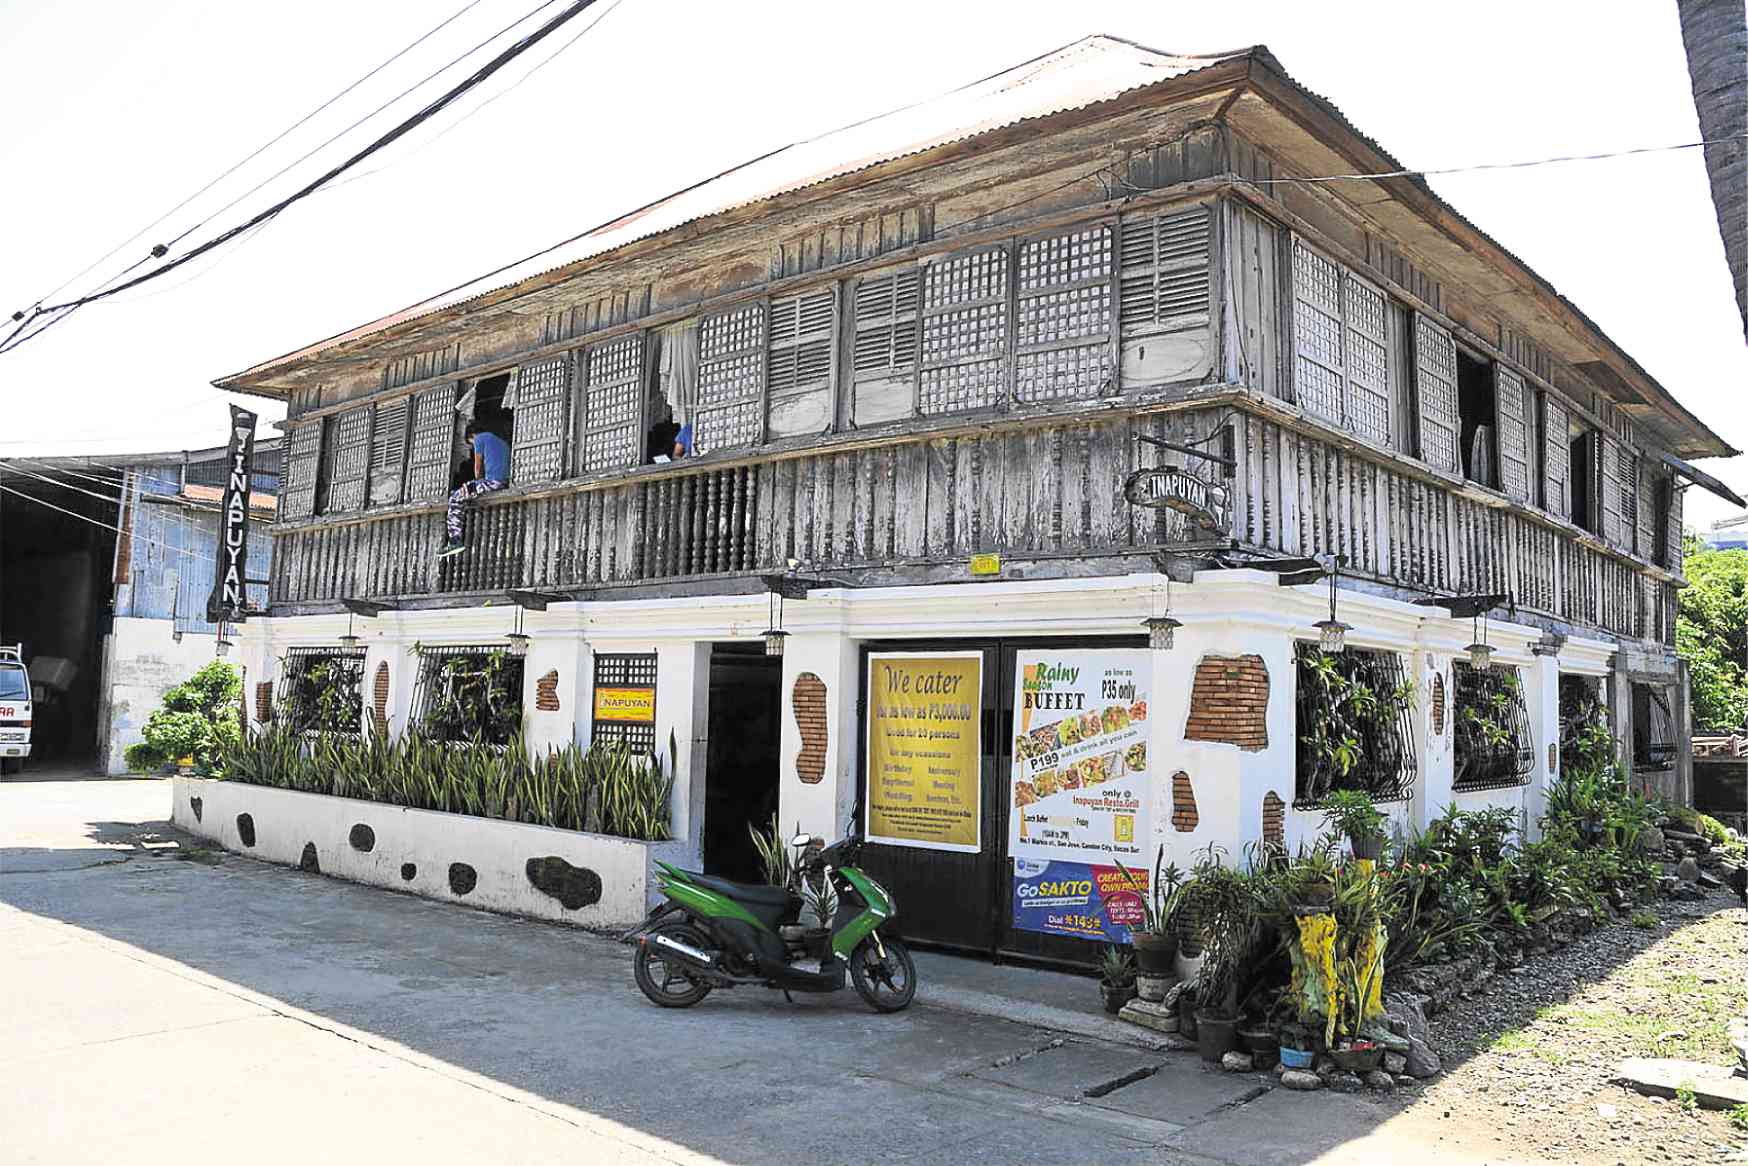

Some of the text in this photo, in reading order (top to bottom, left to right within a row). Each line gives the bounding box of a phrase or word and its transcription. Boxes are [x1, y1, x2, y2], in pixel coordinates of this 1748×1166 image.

[1151, 475, 1206, 507] INAPUYAN
[223, 455, 247, 605] INAPUYAN
[885, 665, 963, 694] We cater
[1036, 662, 1079, 685] Rainy
[1024, 692, 1085, 710] BUFFET
[1102, 680, 1136, 704] P35 only
[1030, 752, 1059, 769] P199
[1074, 795, 1103, 808] Inapuyan
[1102, 789, 1121, 798] only
